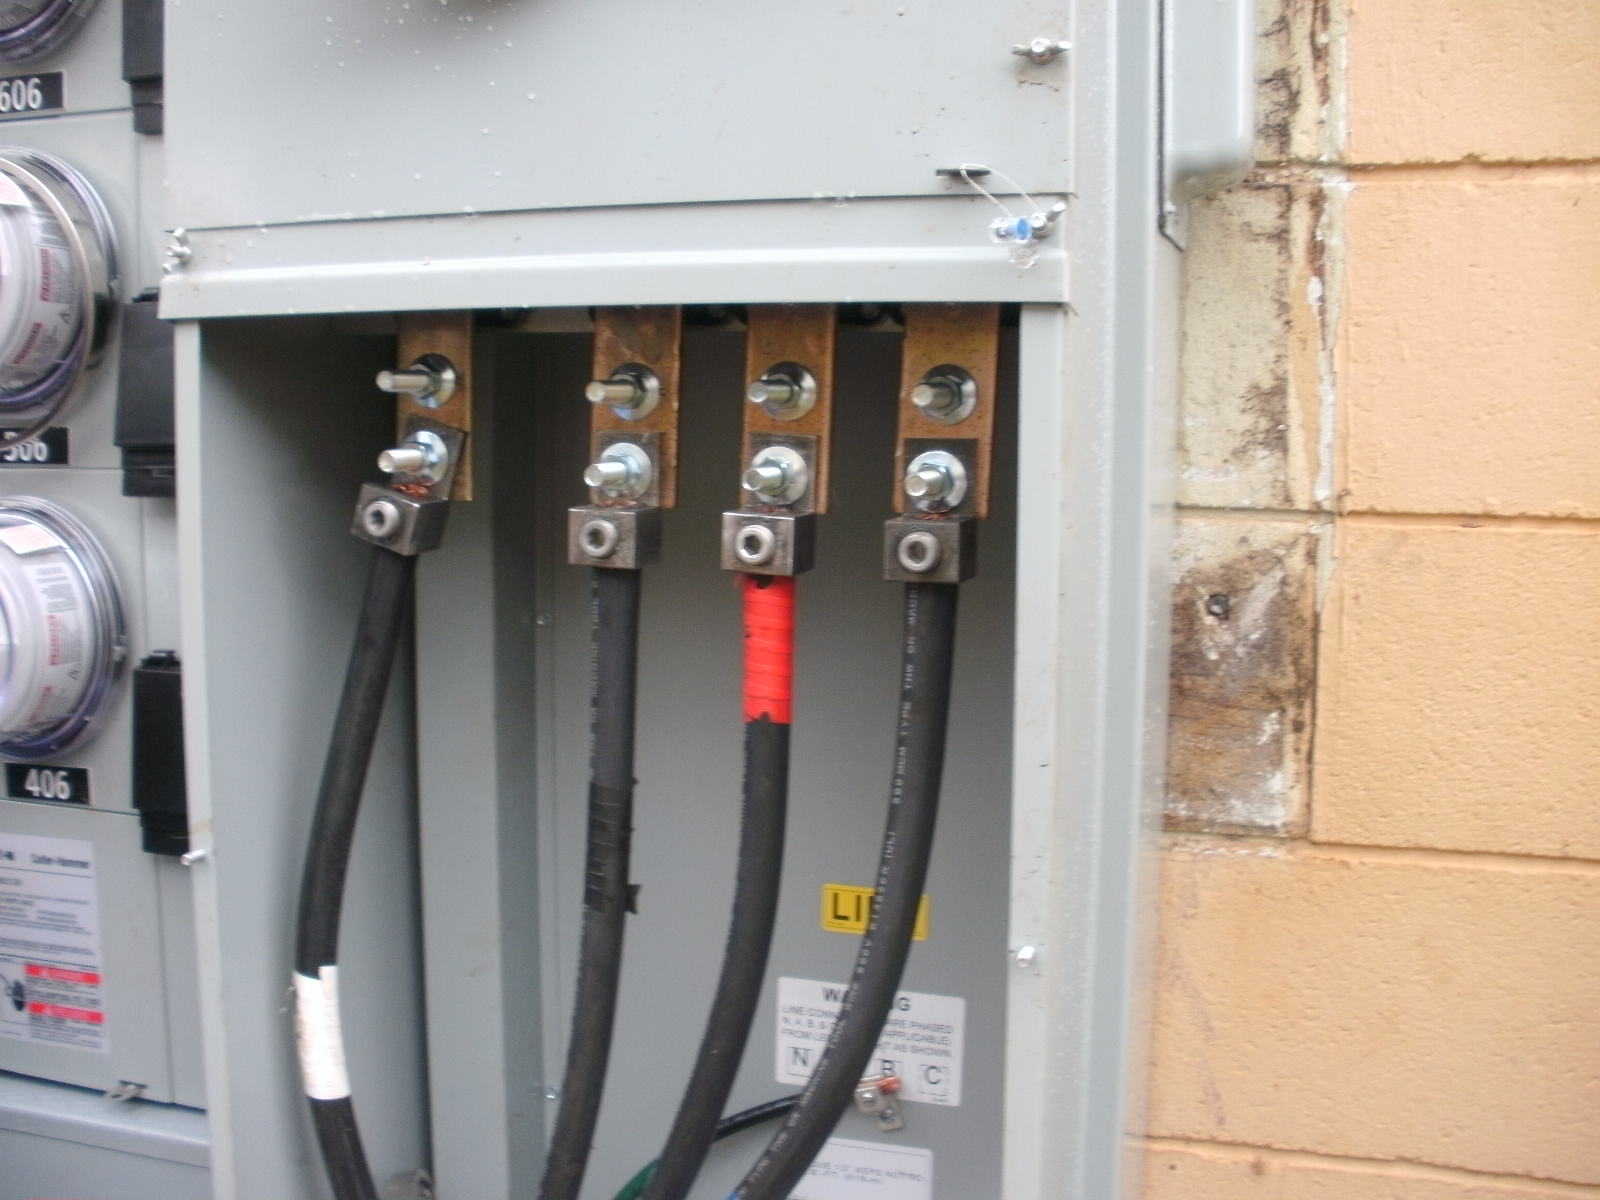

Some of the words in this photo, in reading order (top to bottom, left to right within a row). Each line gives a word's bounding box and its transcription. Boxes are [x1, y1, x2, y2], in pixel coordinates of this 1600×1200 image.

[0, 77, 43, 113] 606
[24, 768, 71, 800] 406
[791, 1048, 810, 1068] N
[923, 1065, 943, 1085] C
